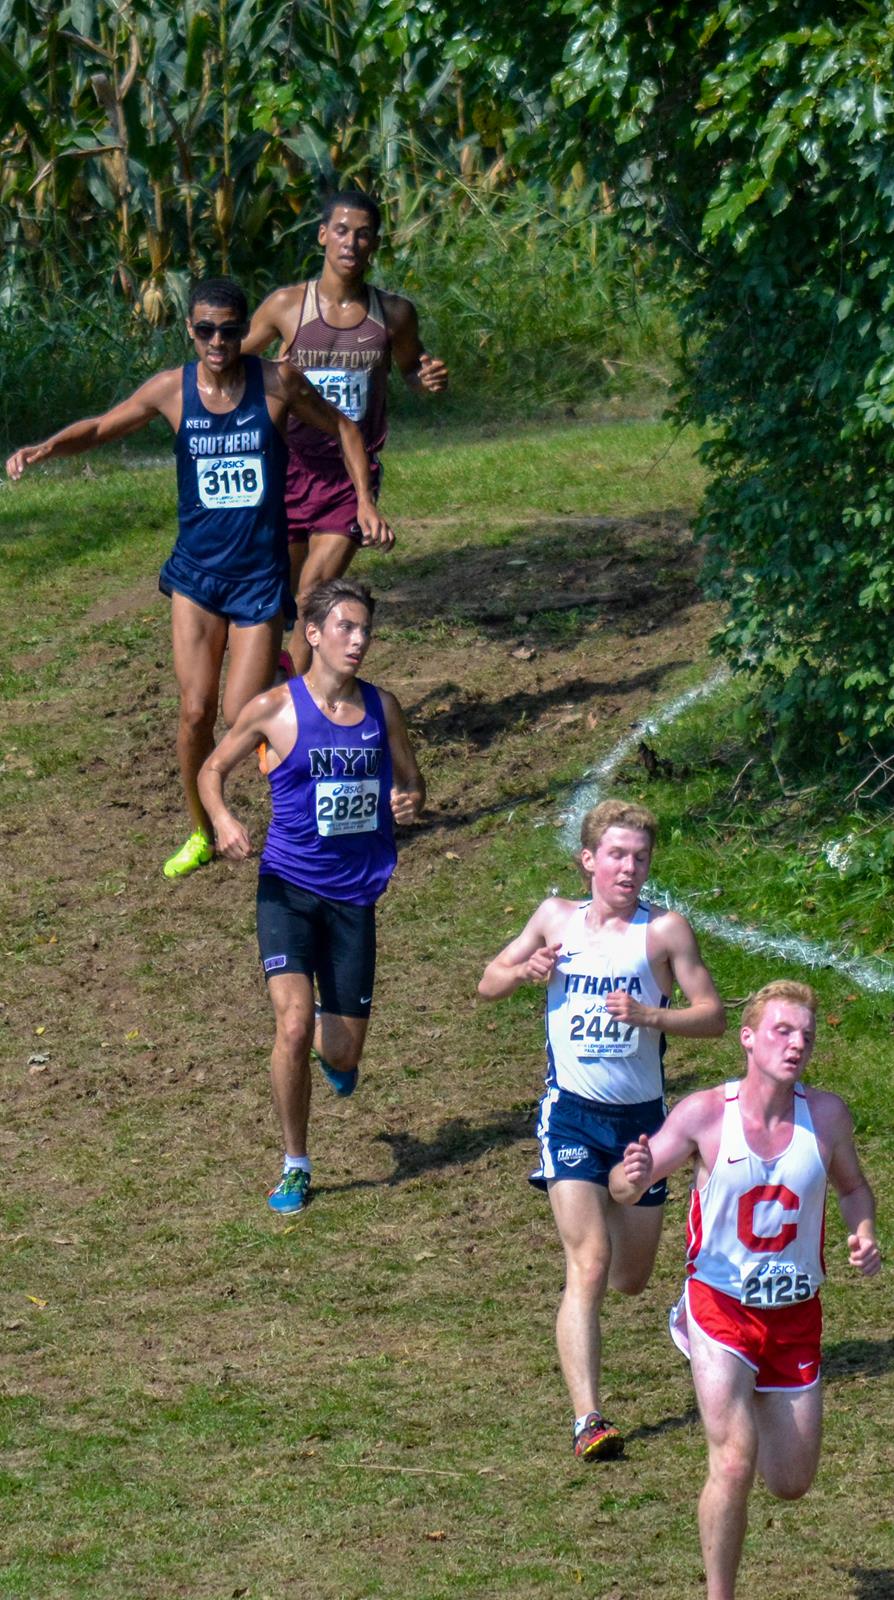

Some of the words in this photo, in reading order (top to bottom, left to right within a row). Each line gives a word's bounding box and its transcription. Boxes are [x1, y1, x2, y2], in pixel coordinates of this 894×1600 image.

[189, 431, 260, 455] SOUTHERN
[204, 468, 258, 496] 3118
[308, 747, 383, 777] NYU
[318, 793, 378, 821] 2823
[564, 974, 642, 996] ITHACA
[737, 1184, 800, 1253] C
[745, 1275, 811, 1304] 2125
